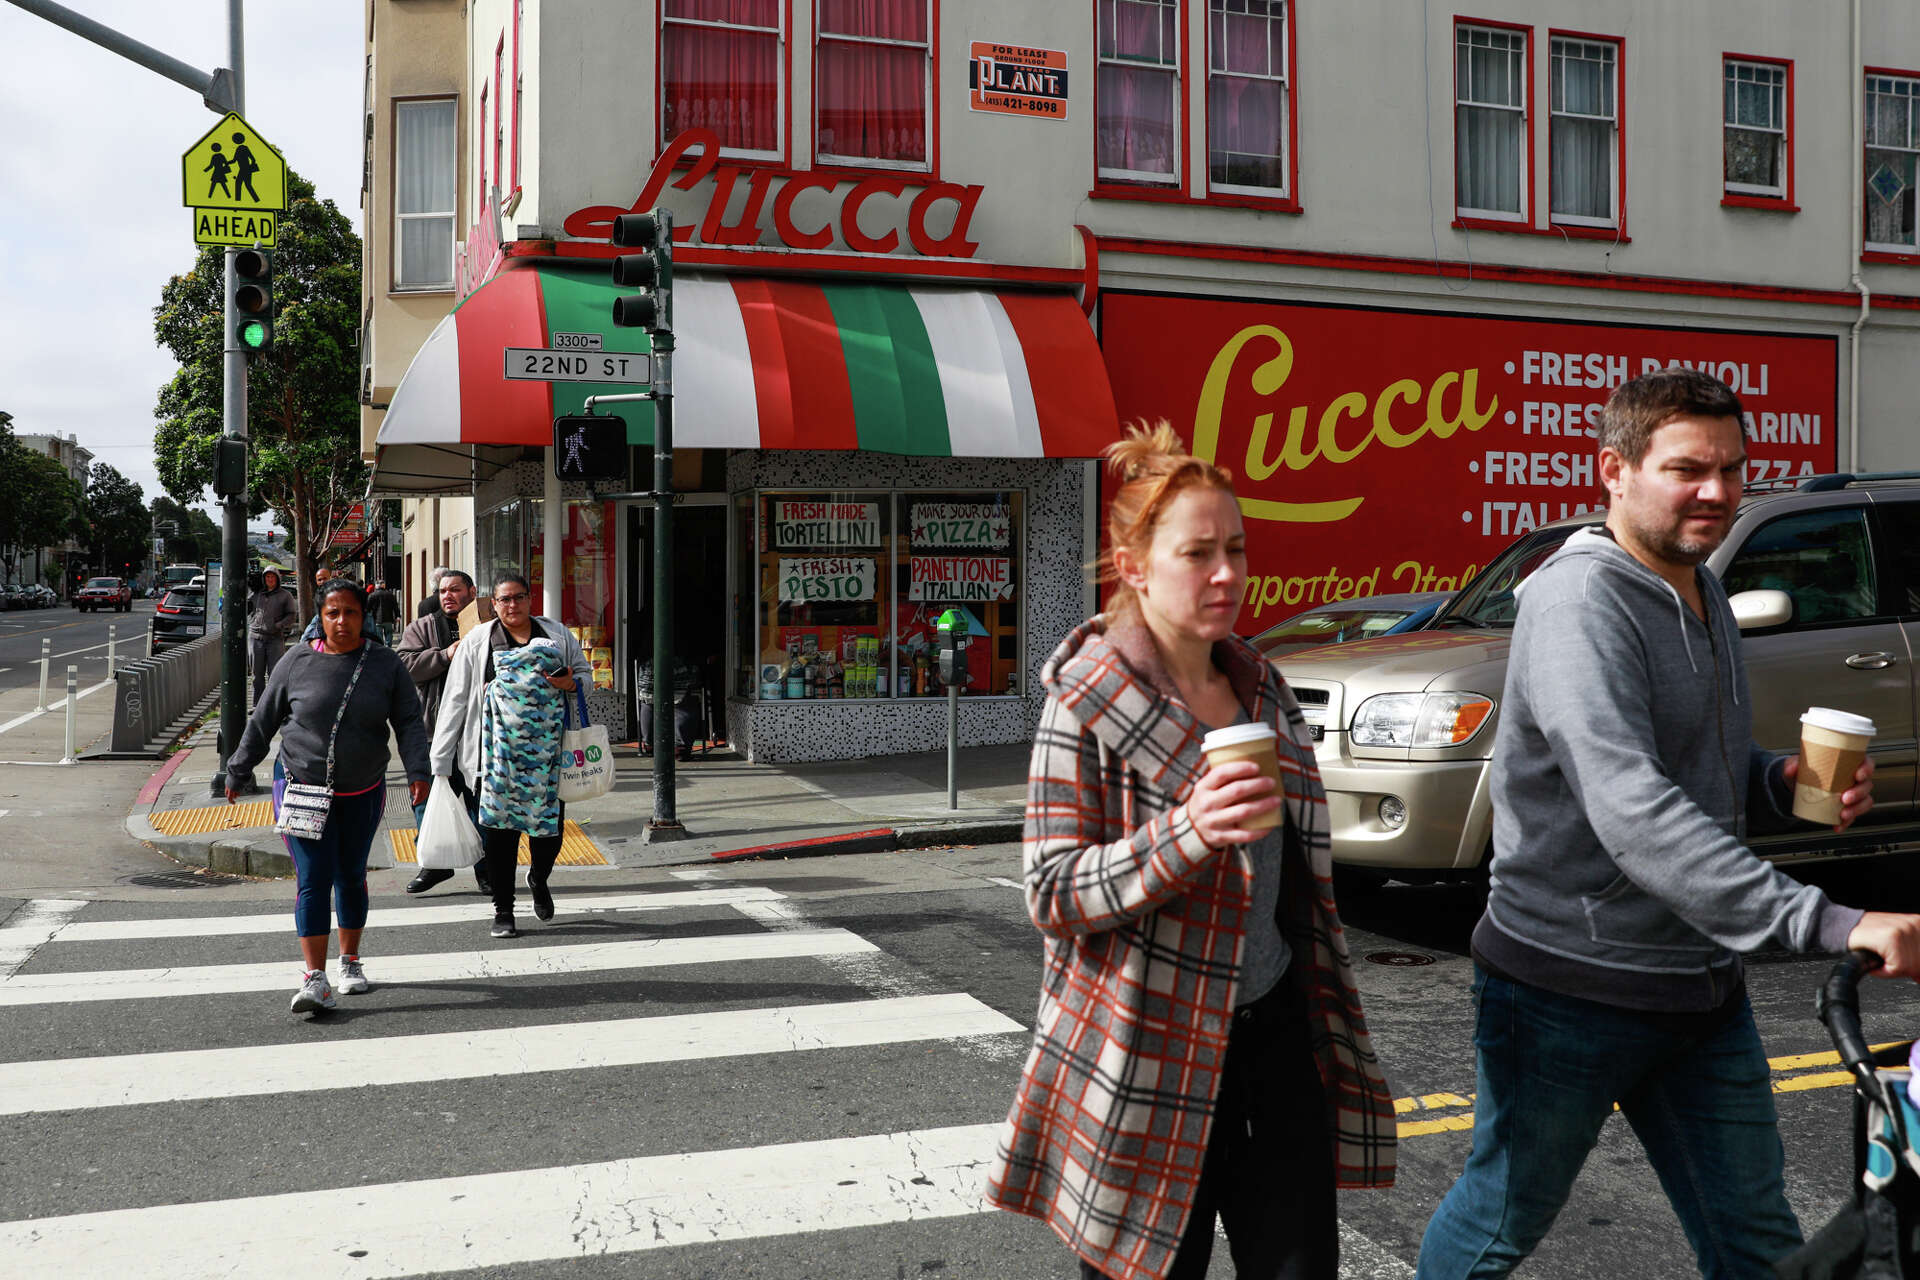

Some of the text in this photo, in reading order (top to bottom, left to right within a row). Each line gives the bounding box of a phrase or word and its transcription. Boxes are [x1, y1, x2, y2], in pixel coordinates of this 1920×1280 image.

[992, 45, 1048, 59] FOR LEASE
[977, 55, 1058, 103] PLANT
[1003, 98, 1057, 113] 421-8098
[563, 127, 984, 258] Lucca
[198, 215, 273, 239] AHEAD
[556, 335, 588, 347] 3300
[525, 355, 630, 377] 22ND ST
[1523, 350, 1628, 388] FRESH
[1192, 324, 1498, 522] Lucca
[1523, 401, 1820, 445] FRES ARINI
[1485, 451, 1815, 488] FRESH IZZA
[783, 503, 867, 520] FRESH MADE
[917, 504, 946, 520] MAKE
[950, 504, 980, 520] YOUR
[776, 521, 875, 545] TORTELLINI
[927, 520, 992, 543] PIZZA
[801, 559, 853, 576] FRESH
[911, 557, 1009, 582] PANETTONE
[784, 575, 863, 599] PESTO
[923, 581, 990, 600] ITALIAN
